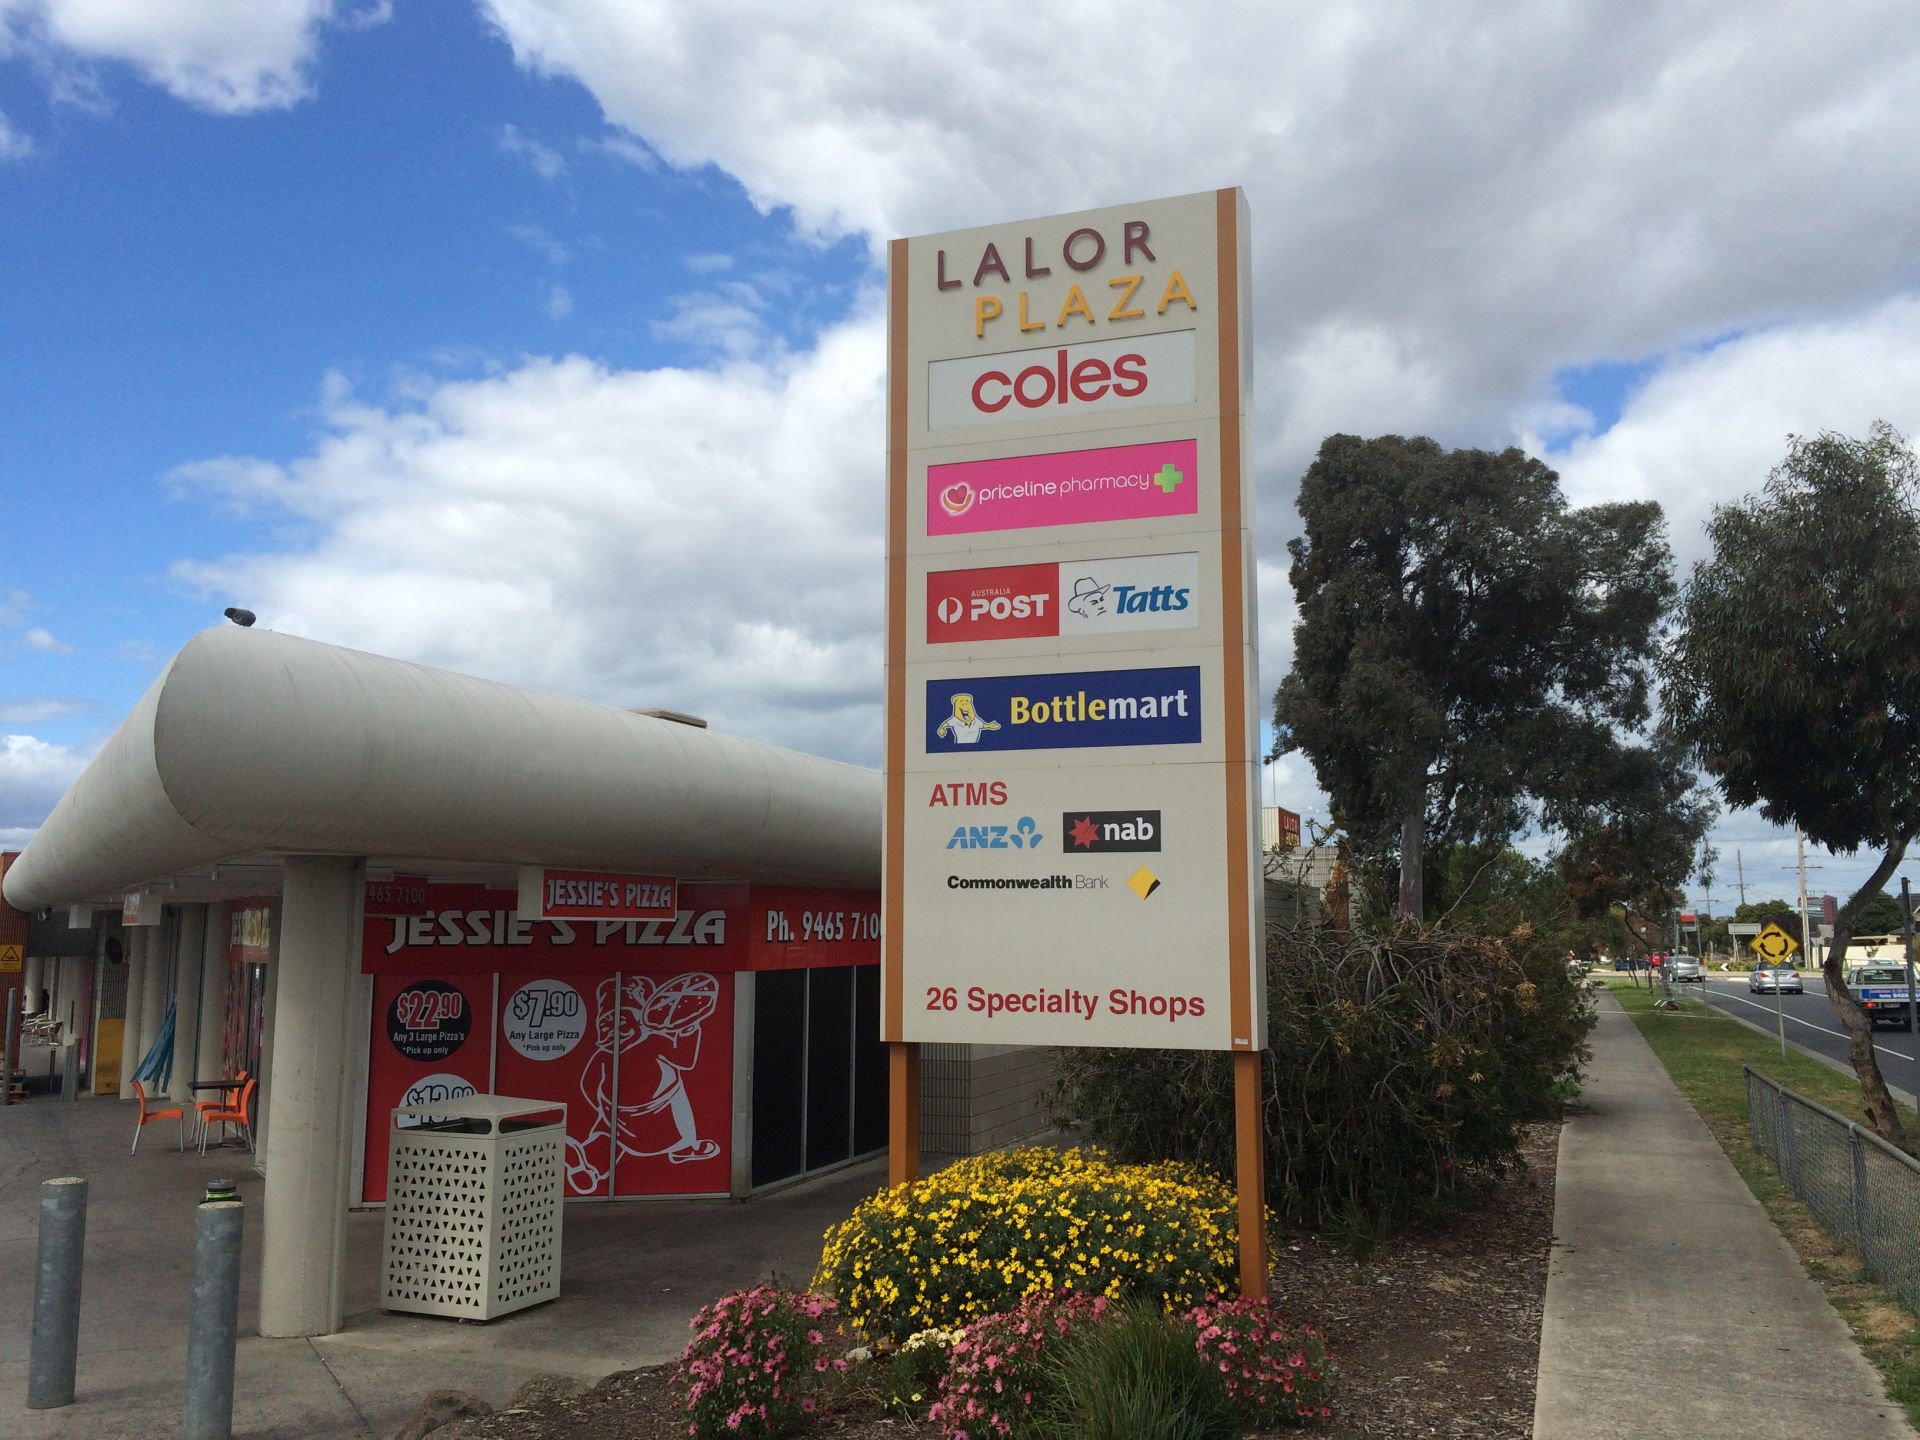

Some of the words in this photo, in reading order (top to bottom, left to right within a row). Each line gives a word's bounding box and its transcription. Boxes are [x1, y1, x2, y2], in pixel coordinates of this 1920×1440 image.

[938, 221, 1156, 290] LALOR
[976, 270, 1197, 337] PLAZA
[972, 350, 1148, 413] coles
[979, 480, 1057, 504] priceline
[1059, 474, 1150, 497] pharmacy
[971, 587, 1011, 598] AUSTRALIA
[1113, 585, 1189, 614] Tatts
[970, 594, 1049, 621] POST
[1011, 689, 1188, 724] Bottlemart
[929, 781, 1008, 807] ATMS
[946, 826, 1008, 849] ANZ
[1103, 817, 1154, 841] nab
[546, 879, 619, 911] JESSIE'S
[625, 883, 672, 908] PIZZA
[947, 875, 1072, 889] Commonwealth
[1075, 875, 1109, 888] Bank
[766, 910, 795, 941] Ph.
[803, 911, 845, 940] 9465
[851, 912, 881, 940] 710
[397, 990, 462, 1030] $22.90
[513, 990, 578, 1027] $7.90
[926, 987, 957, 1011] 26
[967, 987, 1099, 1020] Specialty
[1109, 989, 1205, 1022] Shops
[393, 1032, 407, 1043] Any
[409, 1032, 414, 1041] 3
[416, 1032, 437, 1043] Large
[423, 1047, 431, 1055] up
[434, 1046, 448, 1055] only
[510, 1031, 526, 1041] Any
[529, 1031, 554, 1042] Large
[557, 1030, 579, 1040] Pizza
[552, 1044, 566, 1052] only
